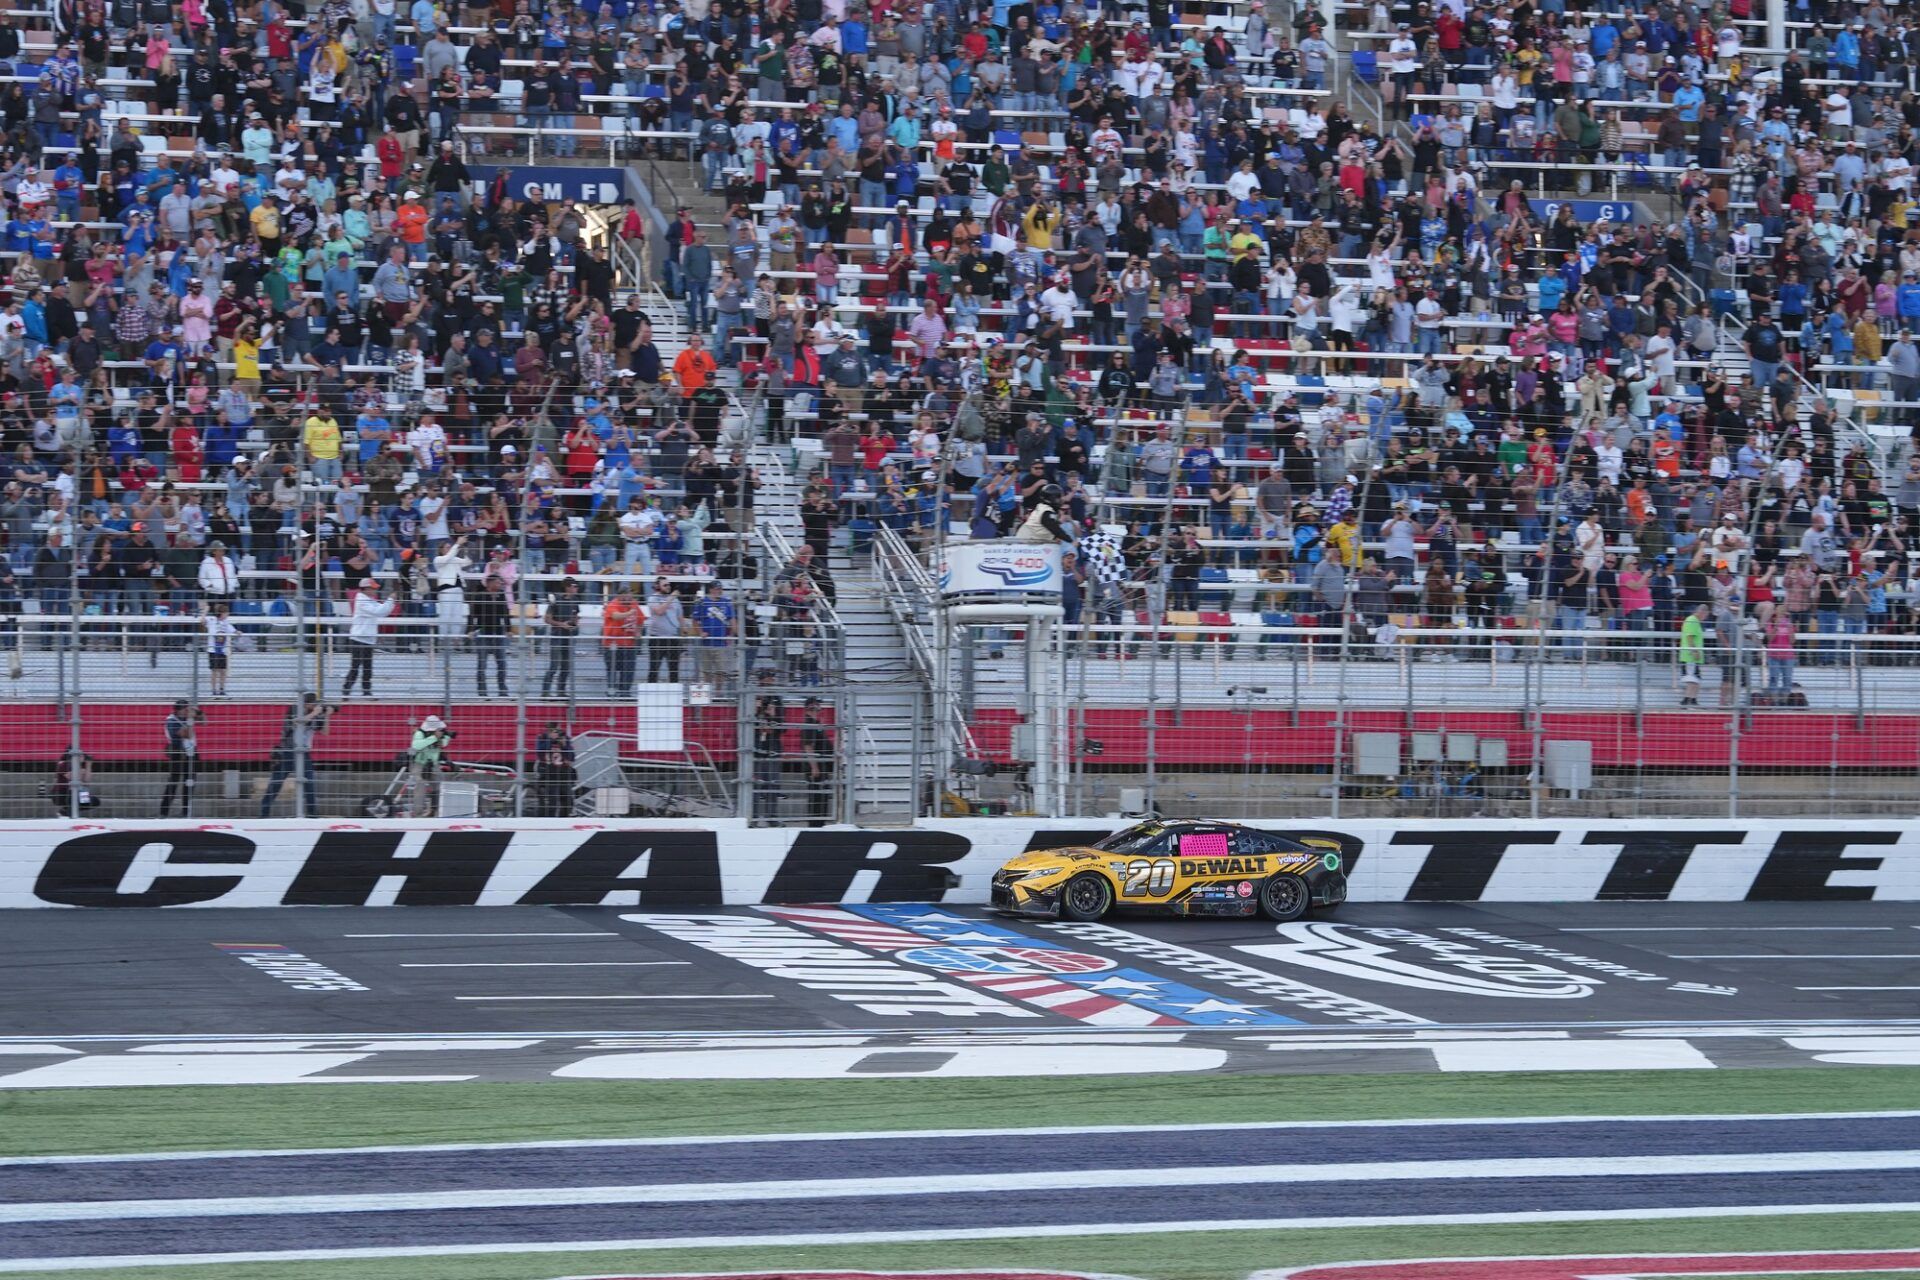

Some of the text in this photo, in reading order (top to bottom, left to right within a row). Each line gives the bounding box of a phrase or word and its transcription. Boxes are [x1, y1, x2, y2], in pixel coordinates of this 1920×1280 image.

[1014, 557, 1043, 569] 400
[34, 831, 1903, 908] CHARTTE
[1122, 859, 1177, 897] 20
[1277, 853, 1309, 865] yahoo!
[229, 952, 372, 991] PLAYOFFS
[617, 913, 1044, 1018] CHARLOTTE
[1431, 952, 1606, 985] 400
